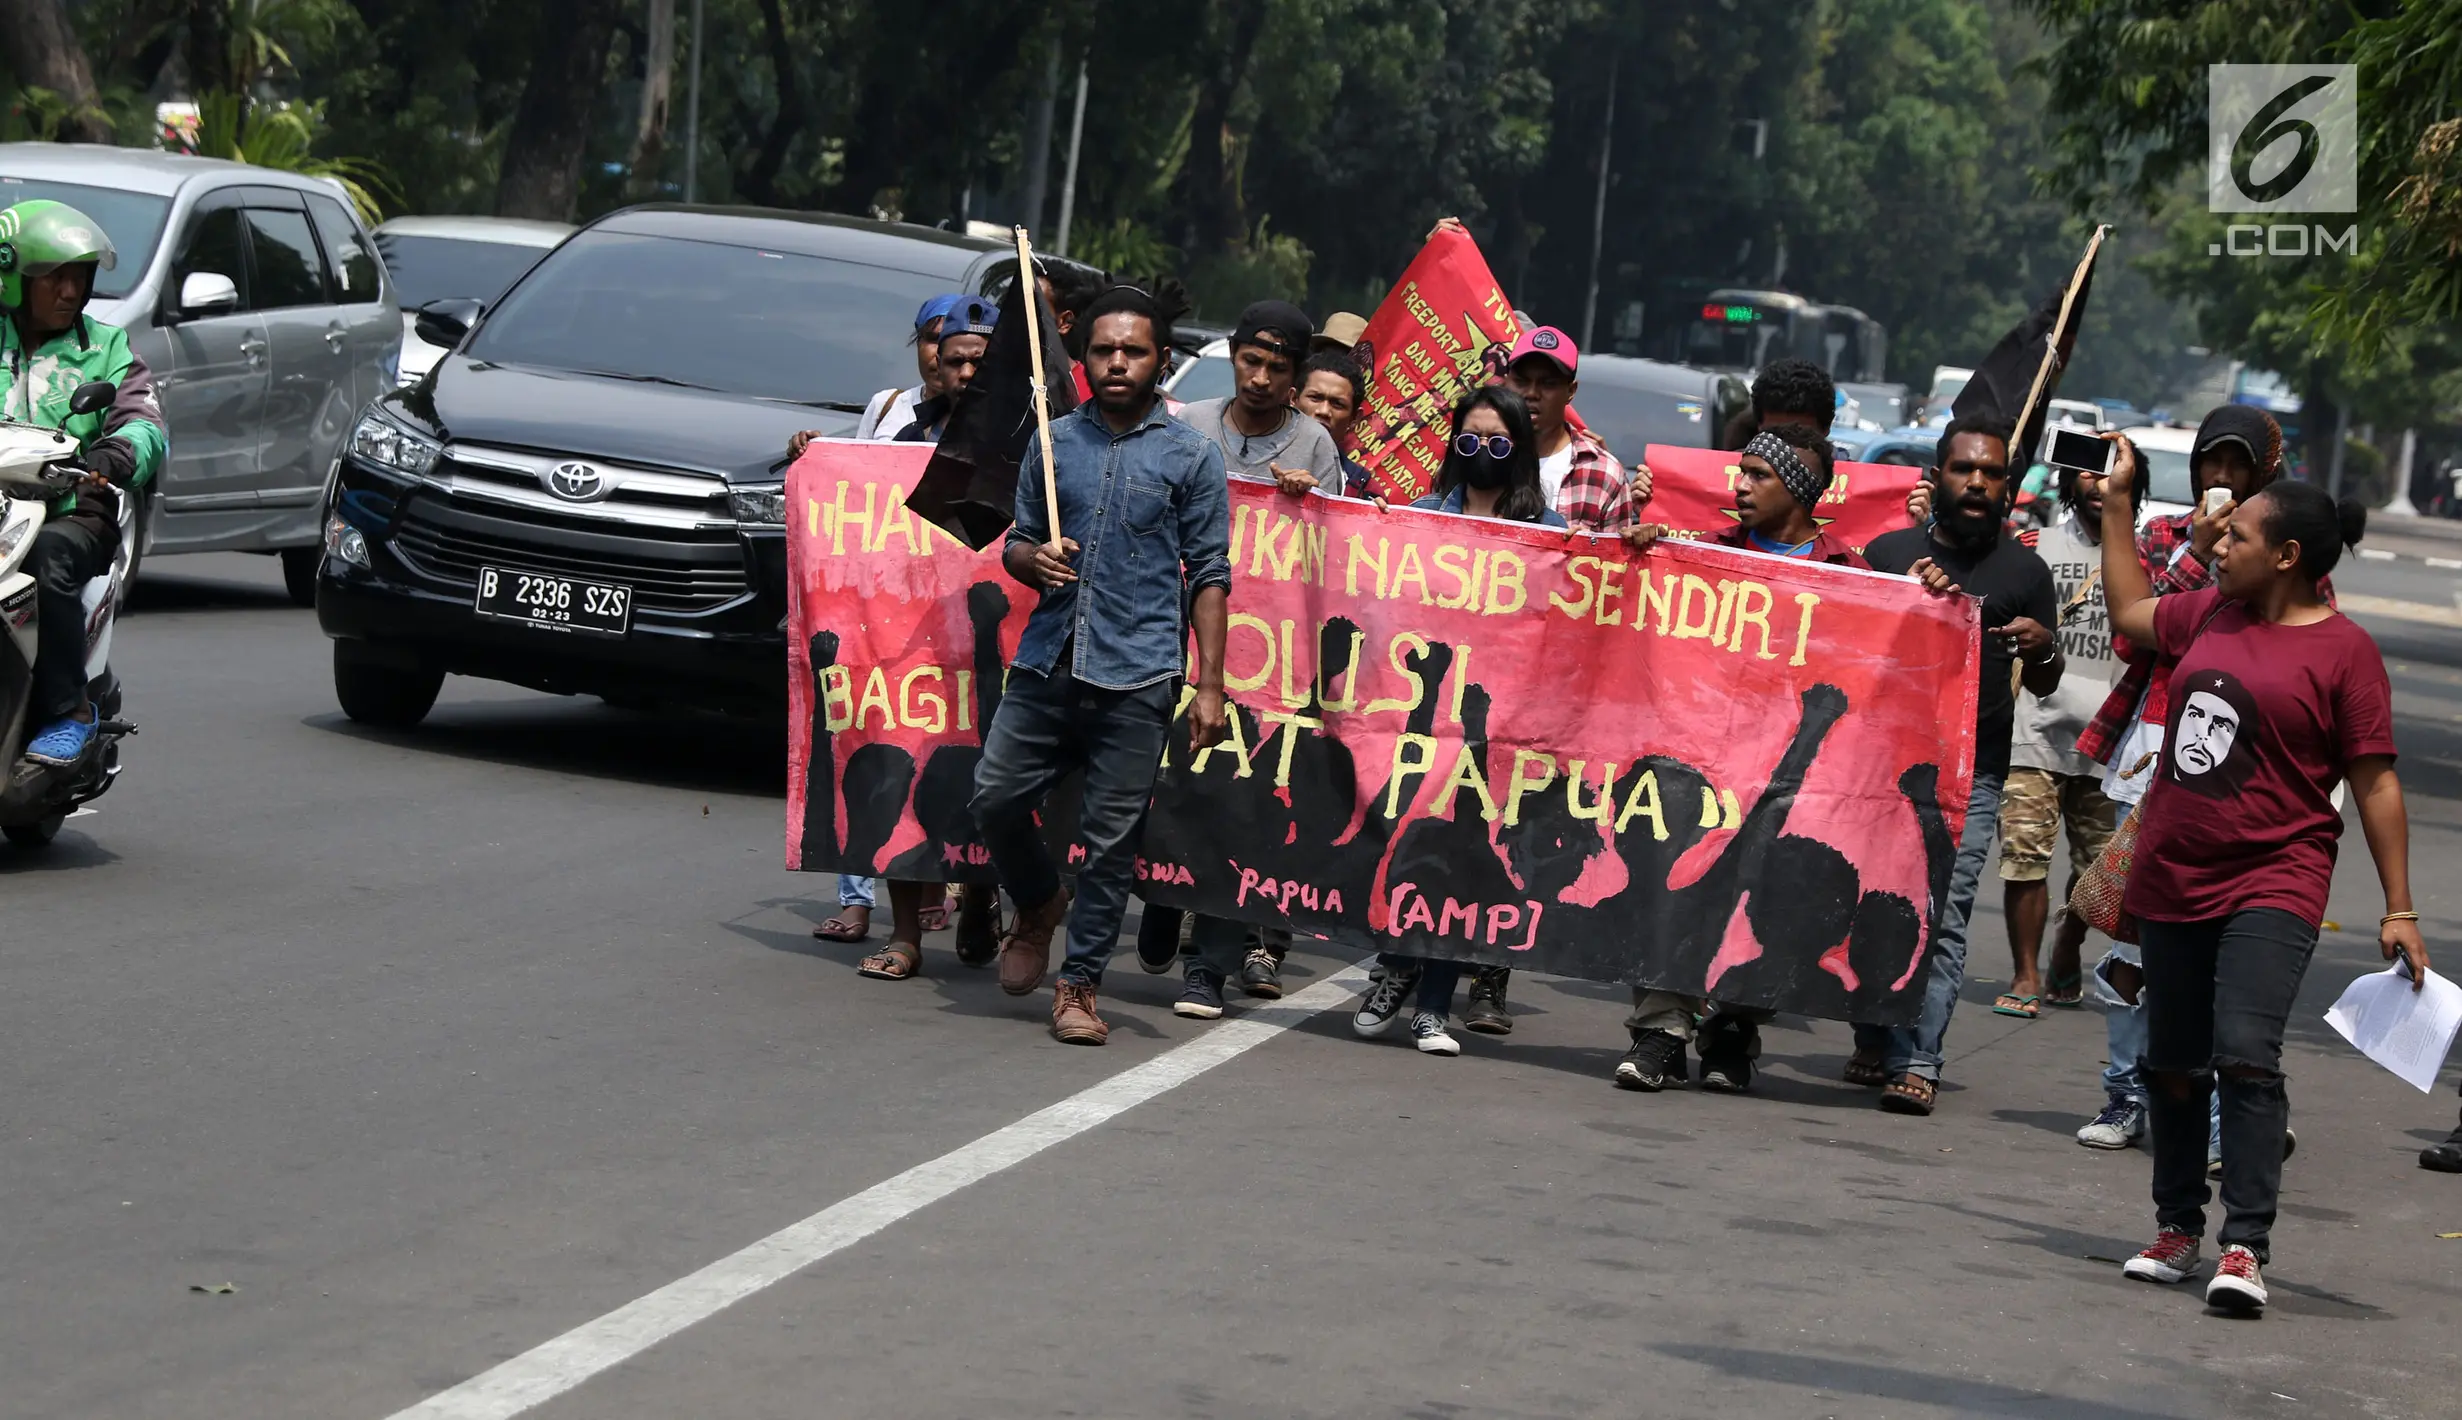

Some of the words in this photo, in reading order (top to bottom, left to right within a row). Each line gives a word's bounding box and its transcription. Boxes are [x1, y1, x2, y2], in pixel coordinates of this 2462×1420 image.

[1400, 281, 1462, 354] FREEPORT
[1384, 352, 1416, 399] YANG
[1404, 341, 1436, 374] DAN
[1355, 419, 1386, 456] SIAN
[1381, 453, 1425, 500] DIATAS
[483, 571, 498, 598] B
[516, 577, 572, 609] 2336
[584, 586, 625, 617] SZS
[1345, 533, 1528, 616] NASIB
[1549, 555, 1821, 667] SENDIRI
[552, 625, 572, 633] TOYOTA
[2057, 631, 2112, 661] WISH
[819, 664, 974, 734] BAGI
[1236, 867, 1344, 917] PAPUA
[1387, 881, 1544, 951] [AMP]
